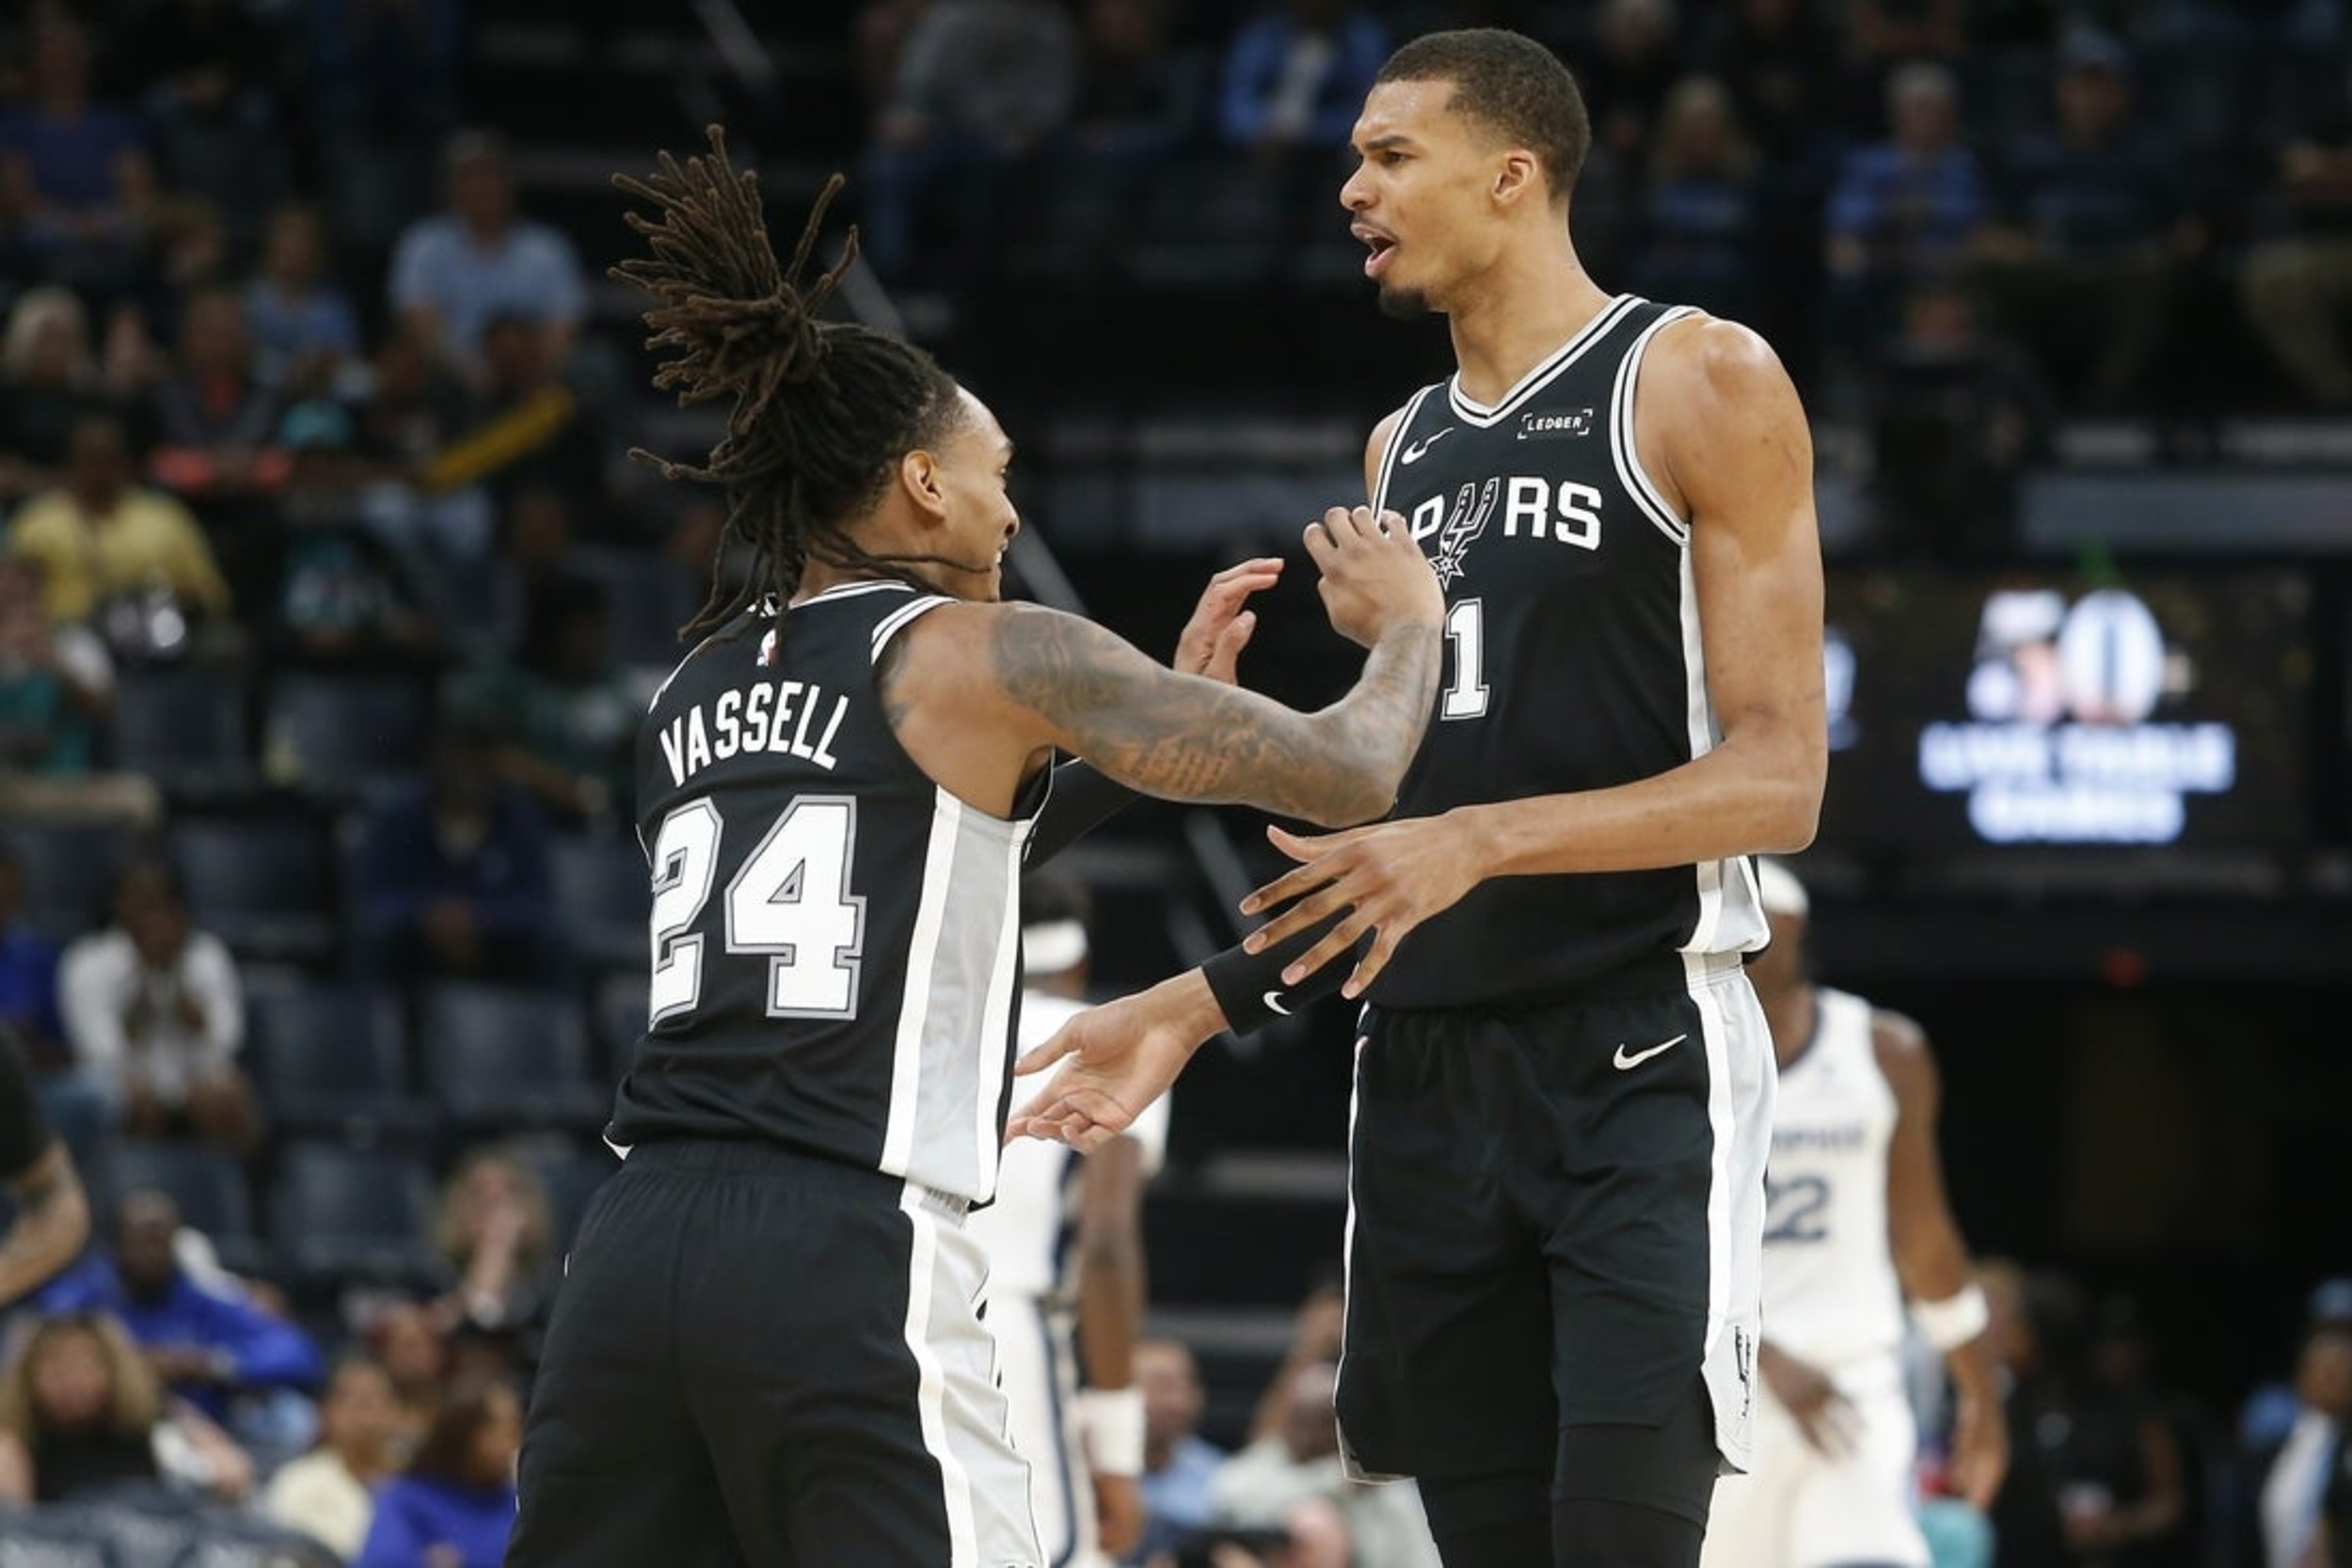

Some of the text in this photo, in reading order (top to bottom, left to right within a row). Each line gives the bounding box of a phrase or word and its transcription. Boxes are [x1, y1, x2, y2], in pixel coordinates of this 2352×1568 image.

[1526, 416, 1582, 432] LEDGER
[1411, 476, 1602, 585] PURS
[1440, 596, 1490, 721] 1
[660, 681, 849, 788] VASSELL
[648, 795, 867, 1033] 24
